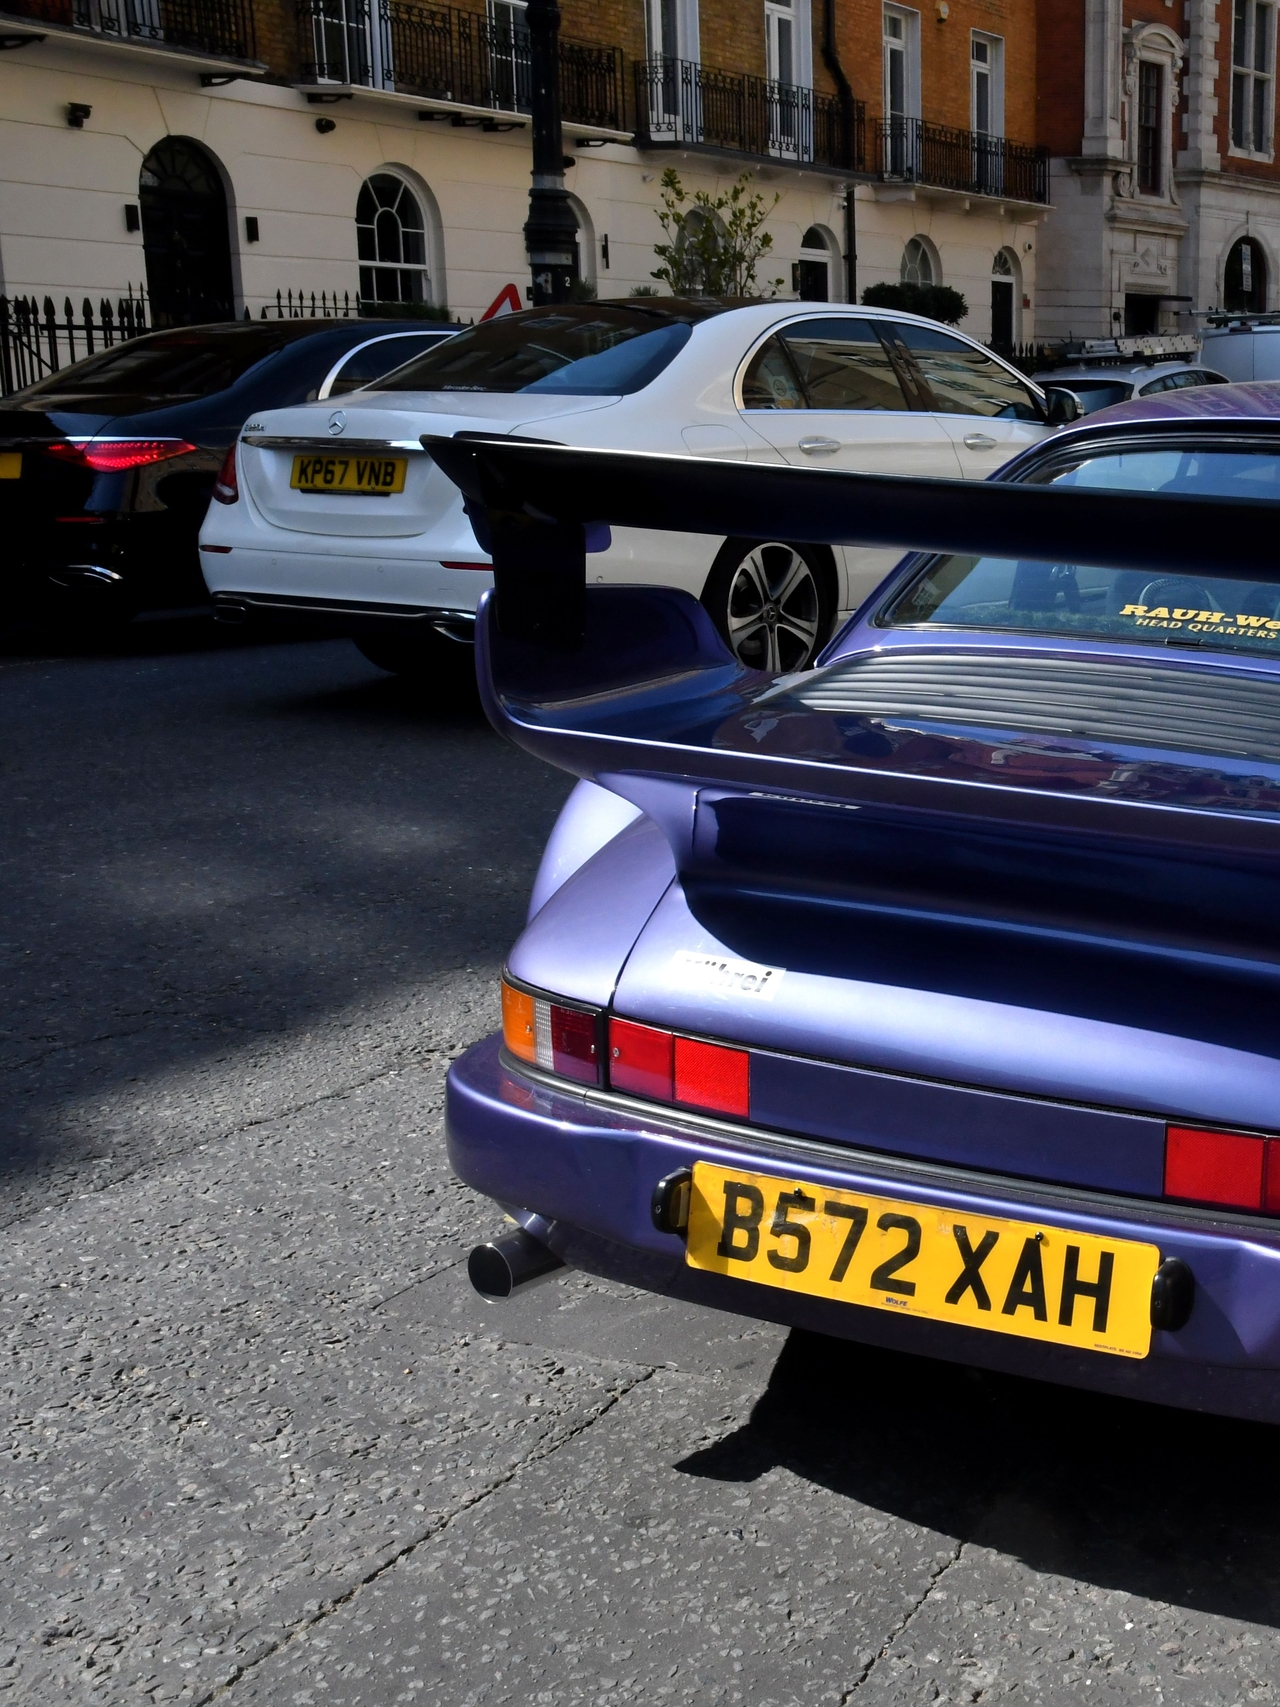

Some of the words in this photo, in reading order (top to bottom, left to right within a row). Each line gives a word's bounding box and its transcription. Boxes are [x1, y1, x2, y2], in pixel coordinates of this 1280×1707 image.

[564, 277, 571, 287] 2
[297, 458, 349, 485] KP67
[356, 460, 396, 487] VNB
[1135, 618, 1183, 629] HEAD
[1188, 623, 1278, 639] QUARTERS
[716, 1180, 923, 1297] B572
[944, 1225, 1115, 1334] XAH
[885, 1296, 908, 1307] WOLFE
